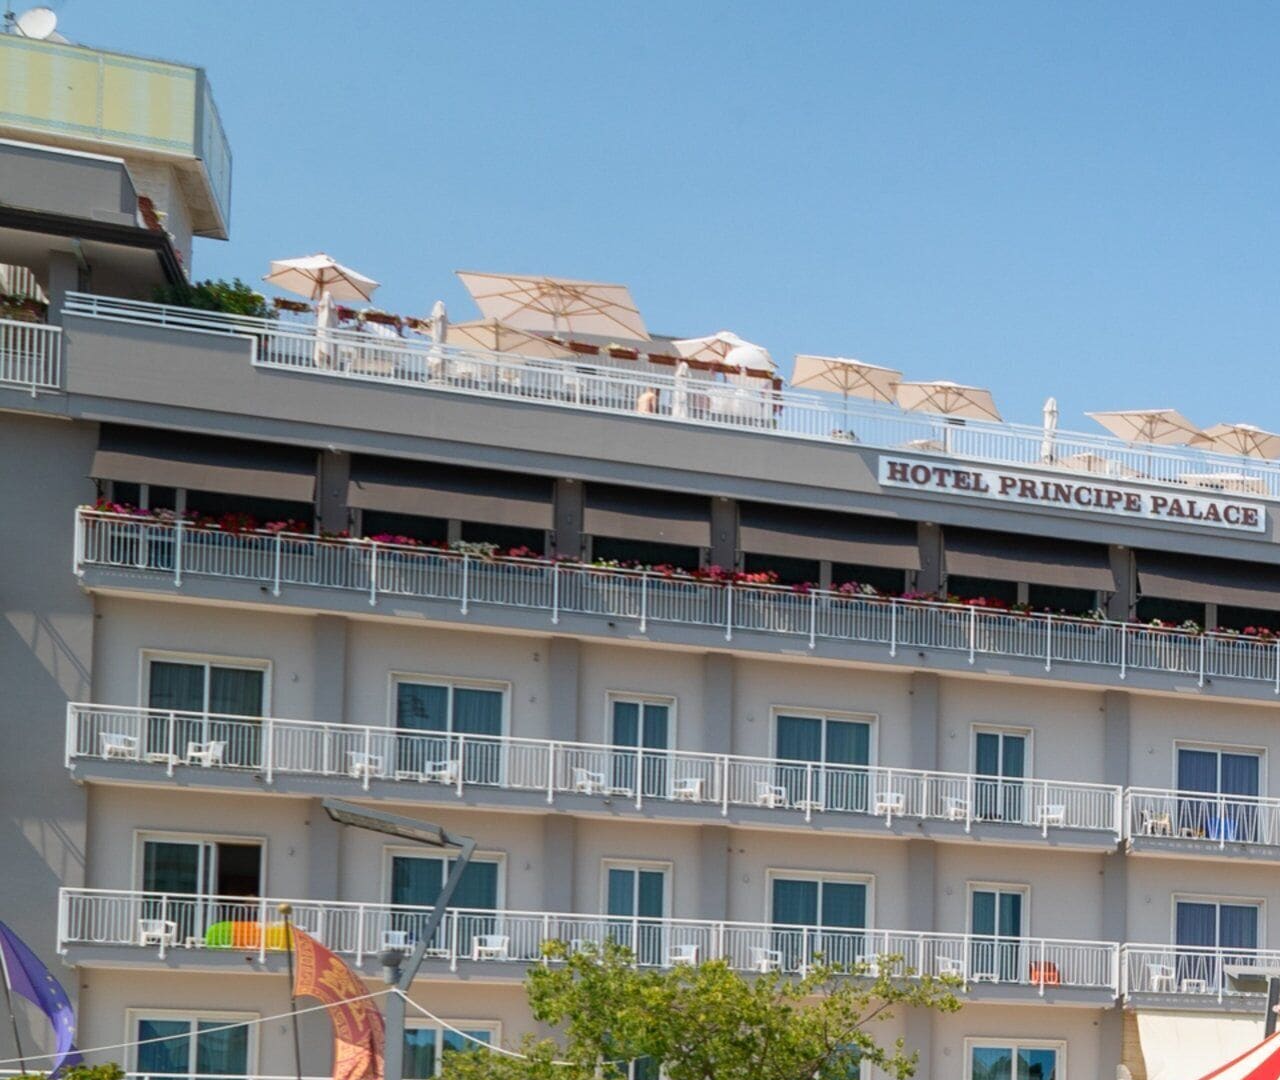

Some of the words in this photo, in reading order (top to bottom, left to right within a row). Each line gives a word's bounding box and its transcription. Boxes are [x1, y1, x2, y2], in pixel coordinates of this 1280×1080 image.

[887, 461, 989, 493] HOTEL
[999, 476, 1141, 512] PRINCIPE
[1150, 496, 1259, 526] PALACE
